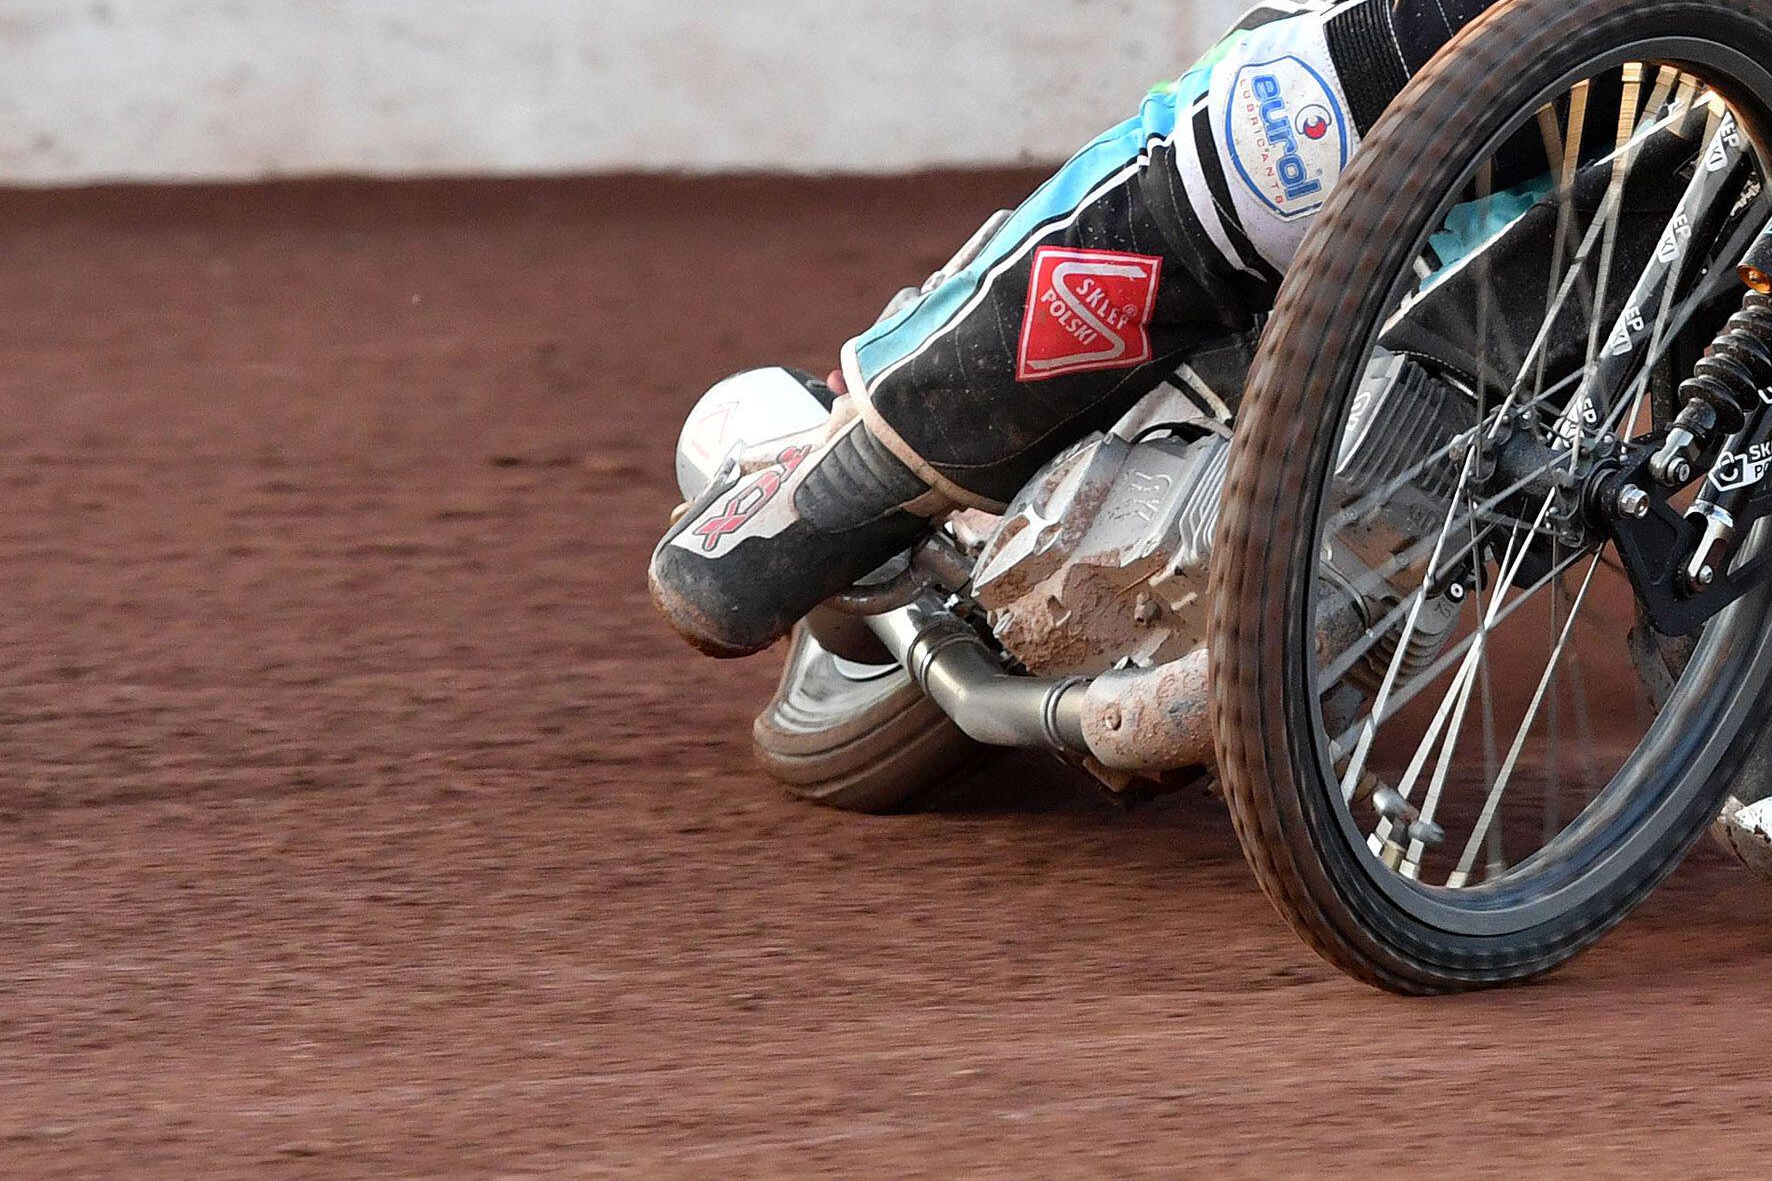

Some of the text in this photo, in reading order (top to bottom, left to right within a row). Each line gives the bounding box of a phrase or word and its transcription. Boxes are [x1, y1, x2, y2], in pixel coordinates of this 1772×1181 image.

[1240, 78, 1285, 205] LUBRICANTS
[1251, 74, 1322, 201] eurol
[1040, 288, 1098, 345] POLSKI
[1075, 278, 1129, 330] SKLEP
